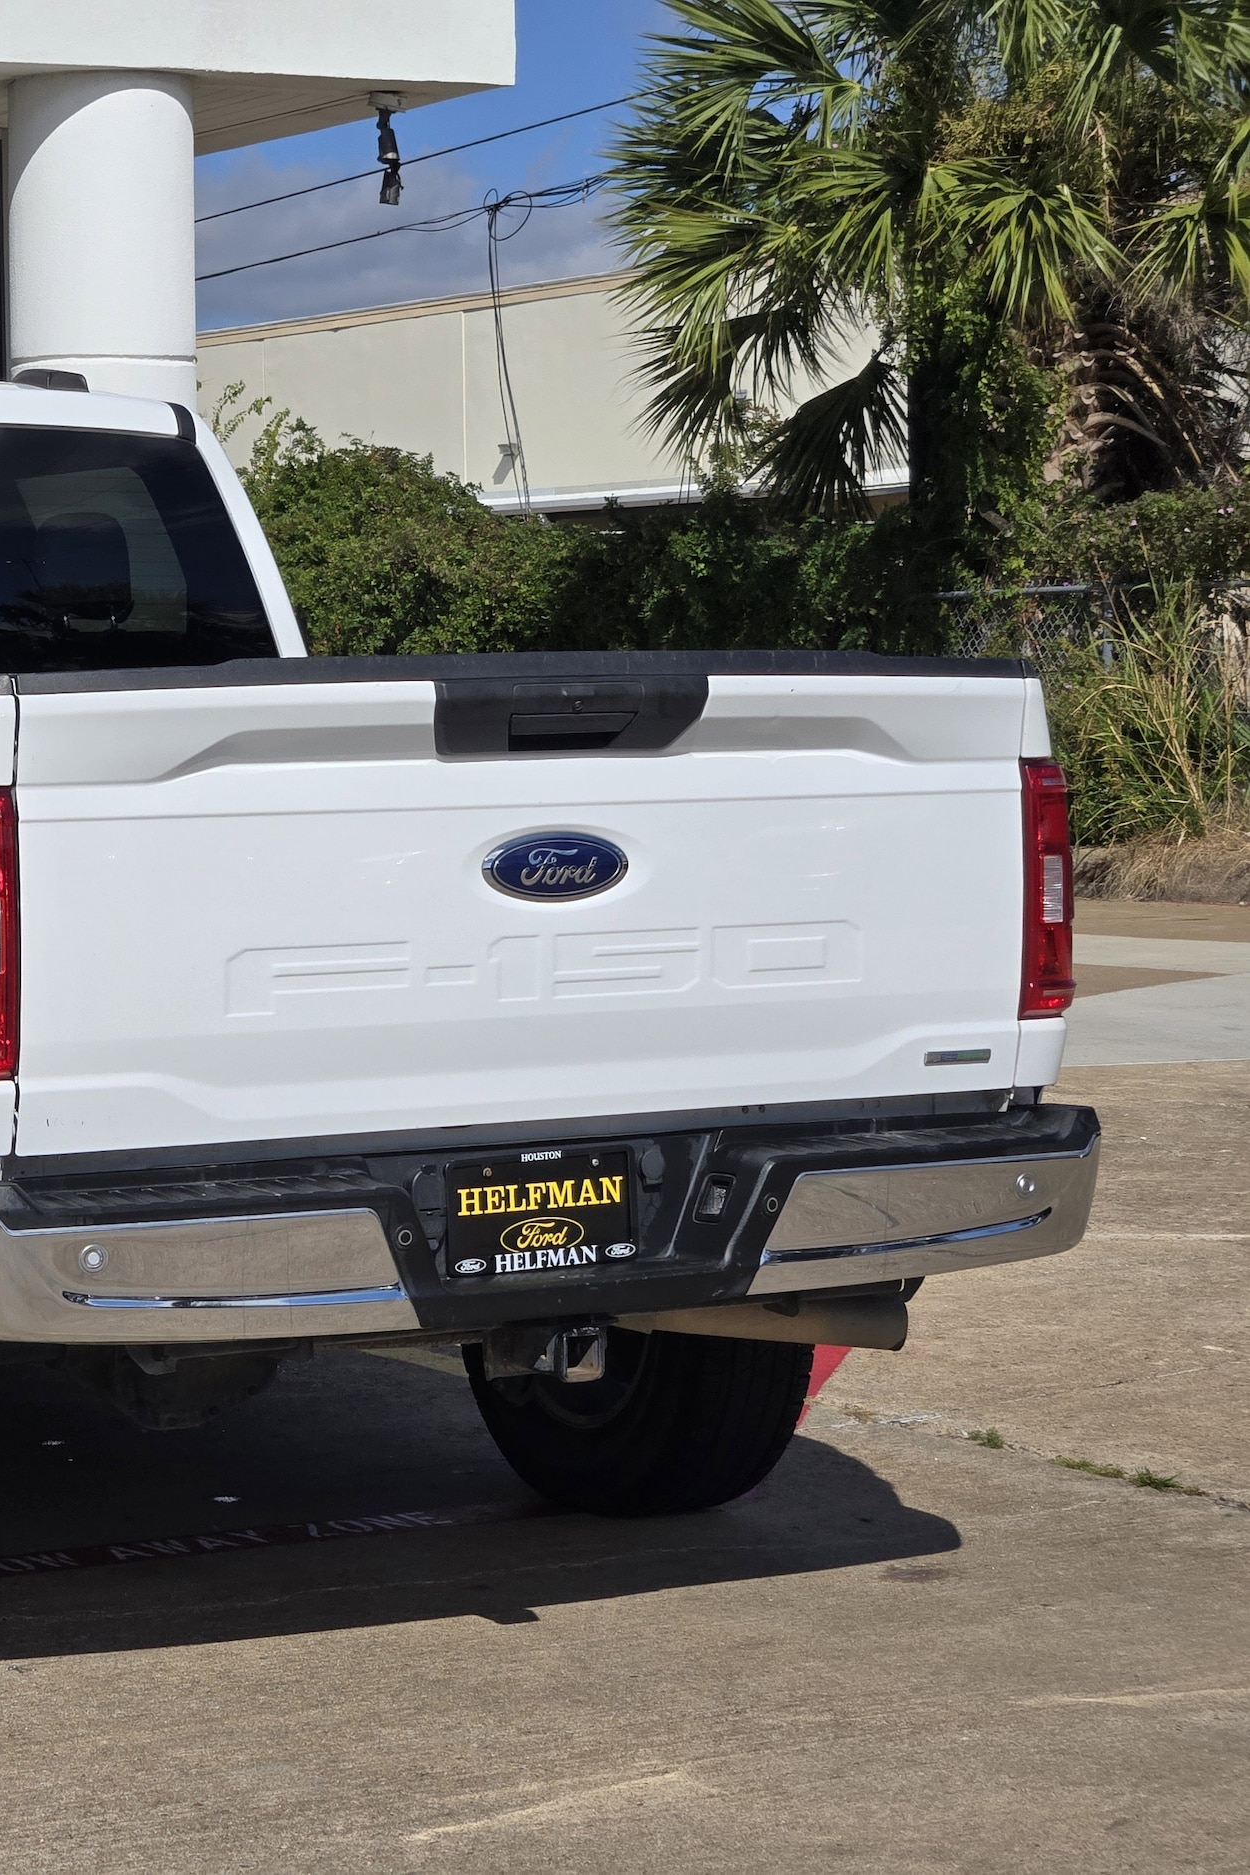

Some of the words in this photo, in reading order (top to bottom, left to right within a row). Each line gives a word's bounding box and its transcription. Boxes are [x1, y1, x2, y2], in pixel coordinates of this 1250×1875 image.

[520, 847, 598, 886] Ford
[225, 920, 862, 1017] F-150
[520, 1150, 562, 1163] HOUSTON
[457, 1176, 623, 1216] HELFMAN
[517, 1221, 568, 1249] Ford
[494, 1245, 598, 1273] HELFMAN
[109, 1528, 269, 1560] AWAY
[286, 1510, 454, 1538] ZONE
